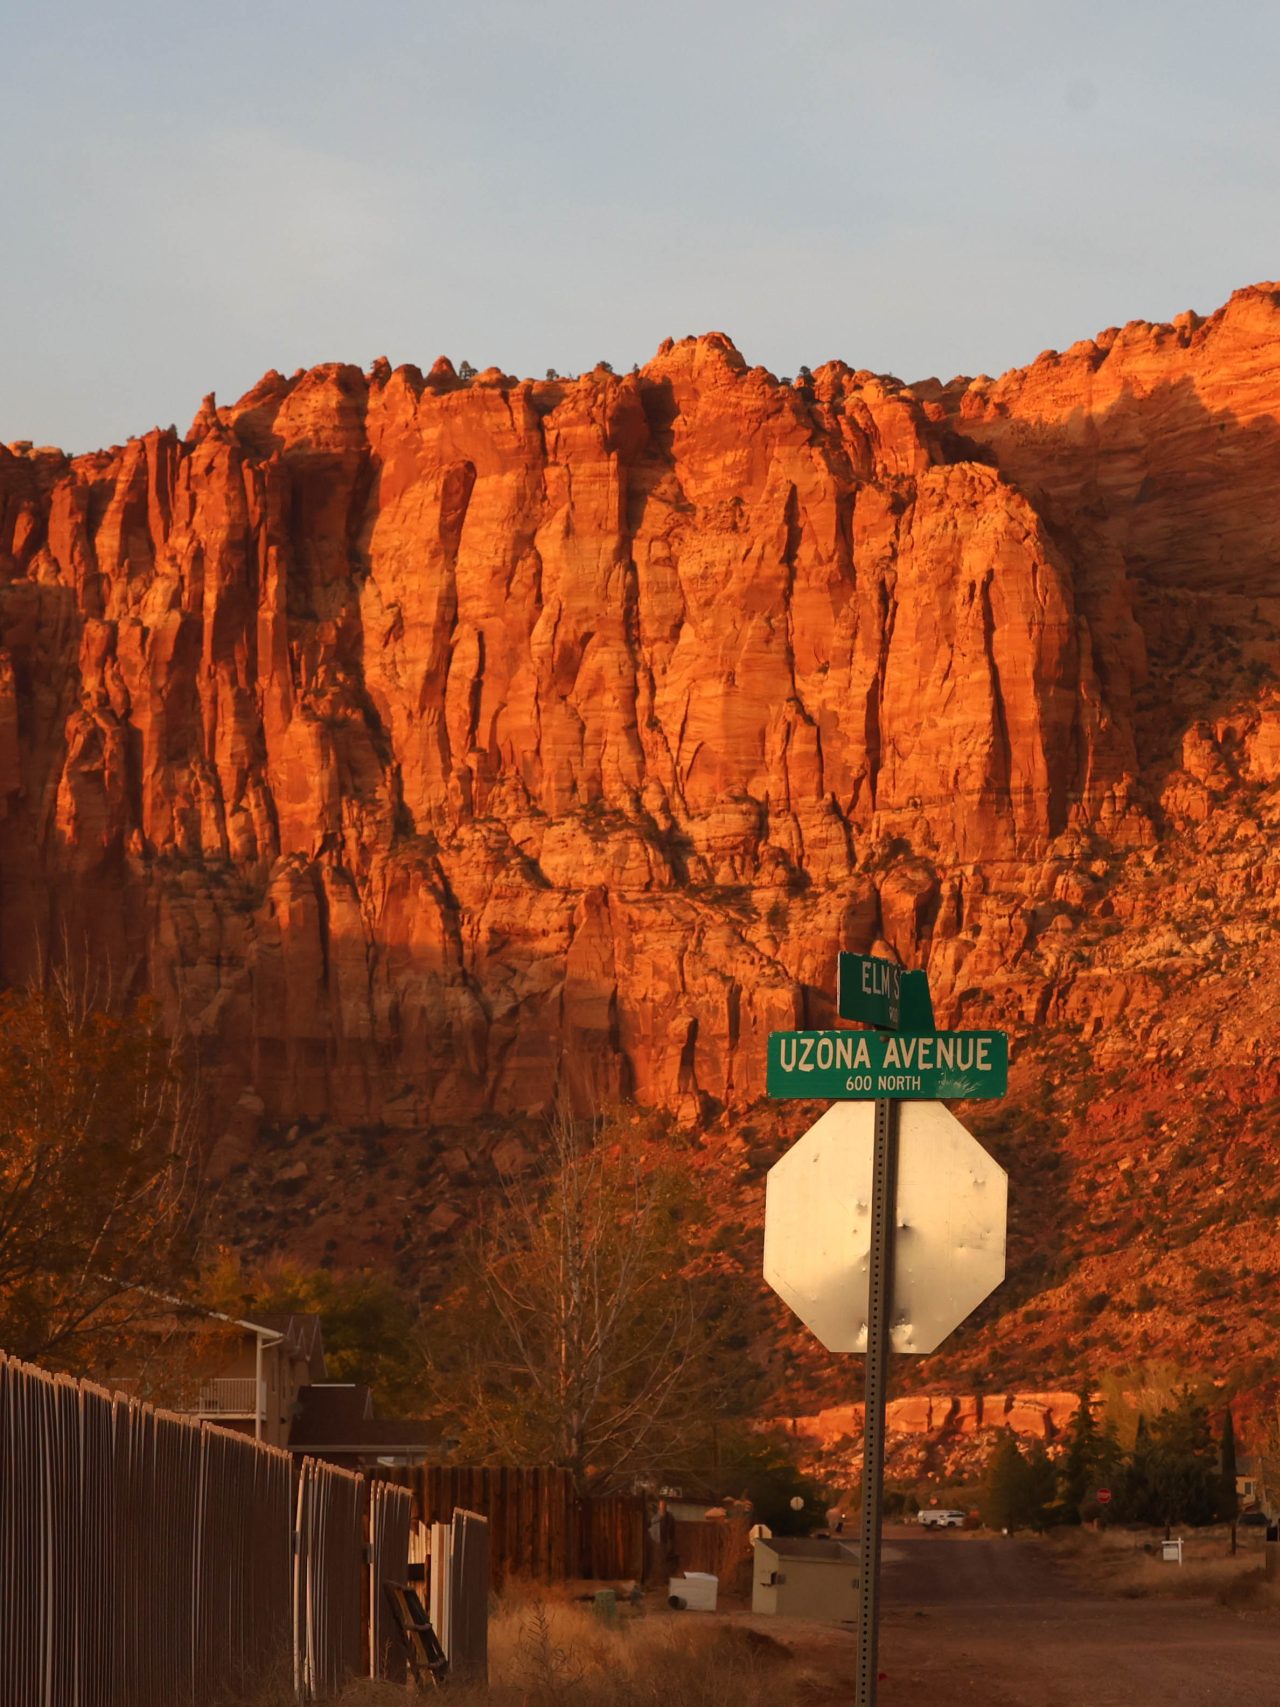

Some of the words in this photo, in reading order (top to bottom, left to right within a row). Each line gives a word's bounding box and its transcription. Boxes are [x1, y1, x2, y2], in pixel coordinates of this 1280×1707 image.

[862, 961, 890, 999] ELM
[780, 1037, 871, 1072] UZONA
[882, 1037, 993, 1072] AVENUE
[846, 1075, 872, 1091] 600
[878, 1075, 921, 1091] NORTH
